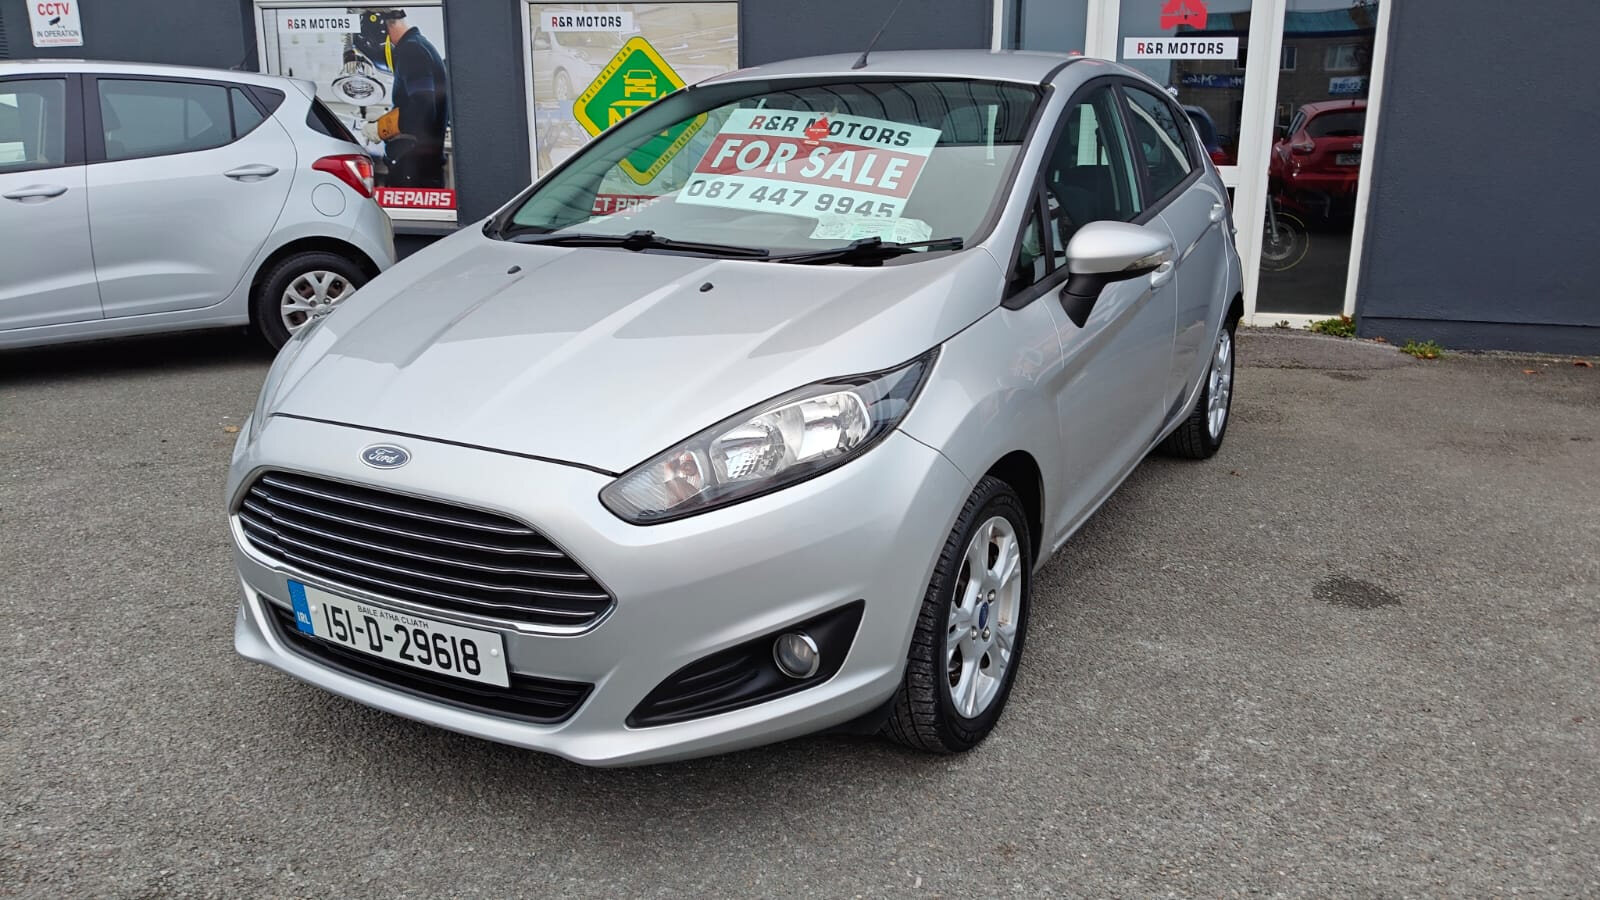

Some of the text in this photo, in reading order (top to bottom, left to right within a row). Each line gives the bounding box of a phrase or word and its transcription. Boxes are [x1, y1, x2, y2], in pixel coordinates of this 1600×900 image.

[37, 3, 69, 15] CCTV
[287, 18, 351, 29] R&R MOTORS
[551, 16, 622, 27] R&R MOTORS
[1137, 42, 1224, 54] R&R MOTORS
[748, 115, 799, 132] R&R
[711, 139, 909, 190] FOR SALE
[383, 190, 452, 206] REPAIRS
[687, 180, 896, 218] 087 447 9945
[368, 448, 399, 463] Ford
[296, 612, 311, 625] IRL
[357, 605, 378, 617] BAILE
[401, 616, 429, 629] CLIATH
[322, 602, 481, 677] 151-D-29618
